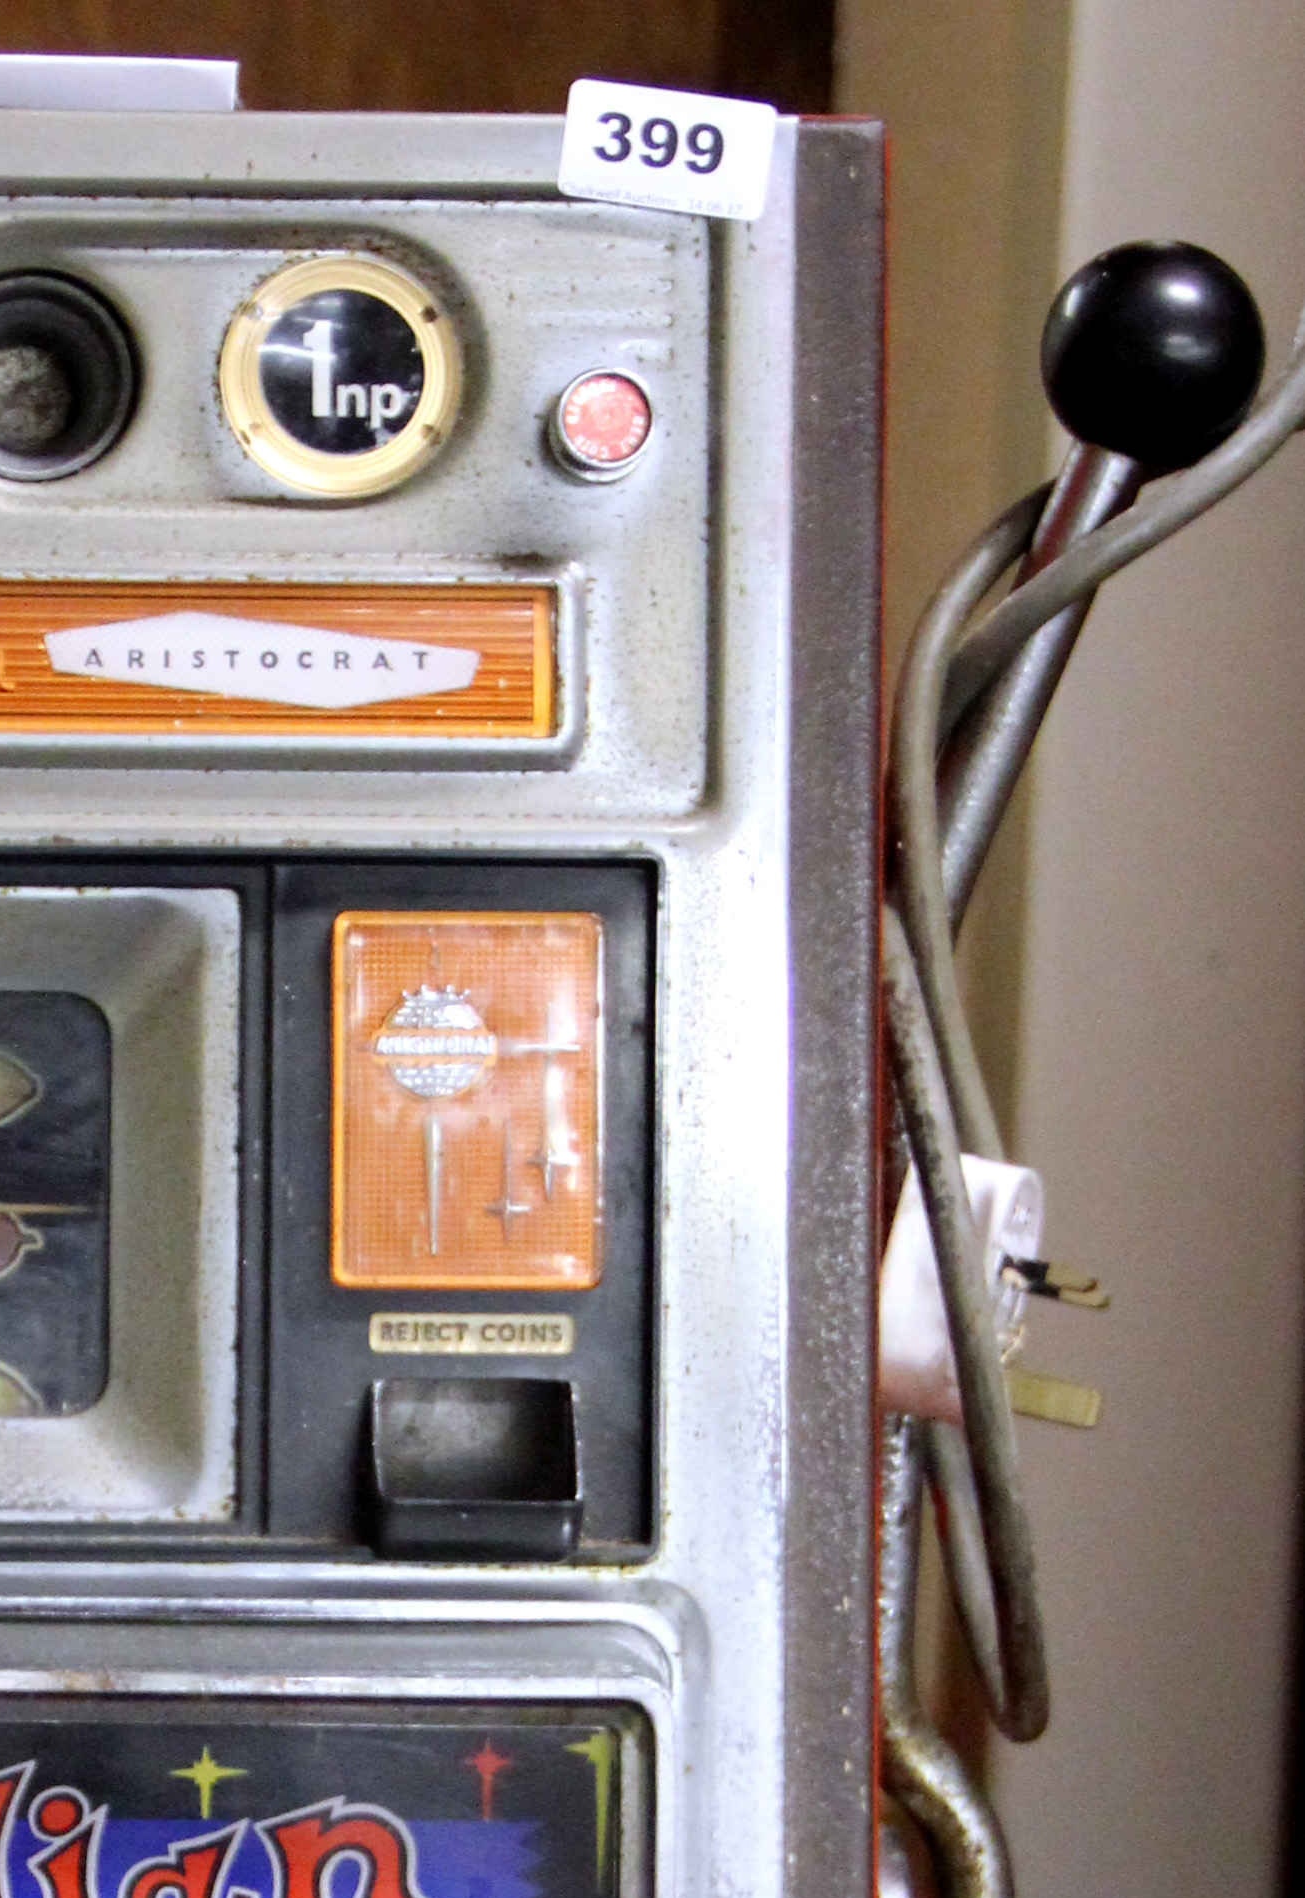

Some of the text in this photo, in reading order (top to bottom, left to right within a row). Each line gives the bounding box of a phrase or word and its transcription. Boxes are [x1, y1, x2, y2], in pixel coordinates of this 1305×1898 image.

[593, 112, 724, 174] 399
[561, 181, 621, 199] Chalkwell
[623, 190, 677, 208] Auctions
[85, 646, 428, 672] ARISTOCRAT
[380, 1321, 563, 1343] REJECT COINS
